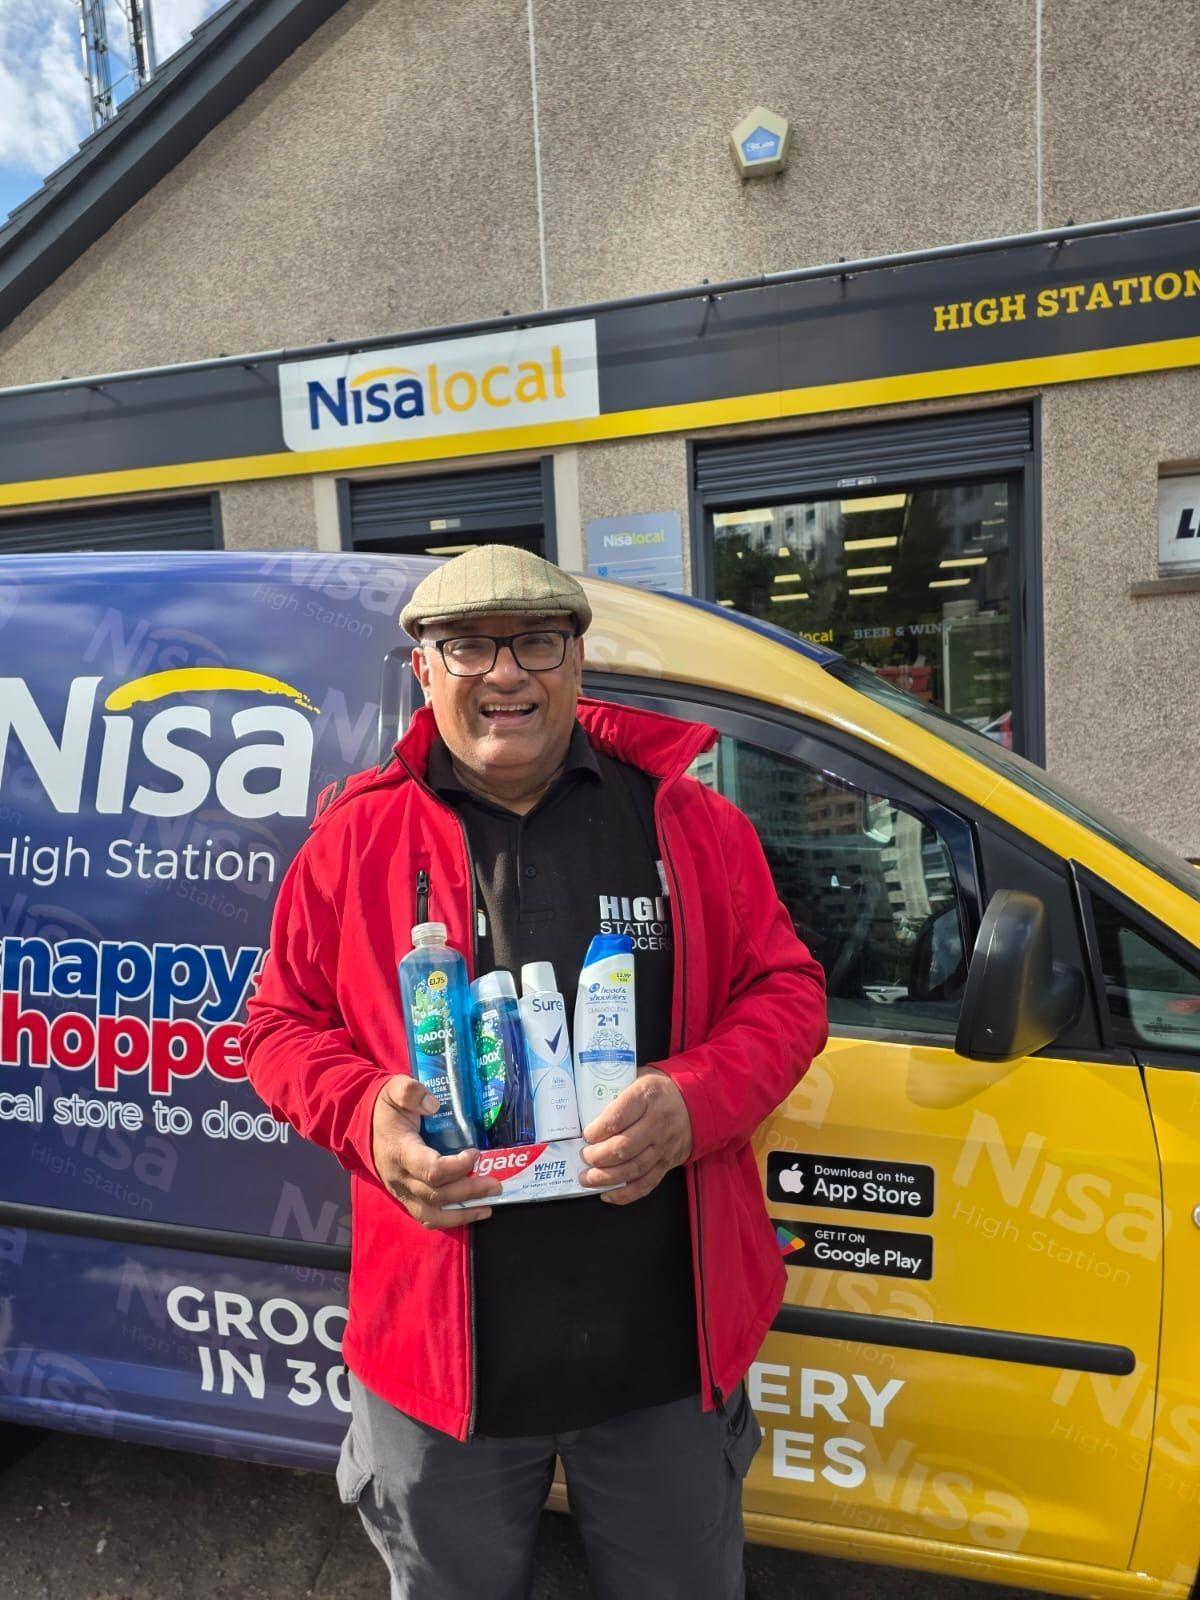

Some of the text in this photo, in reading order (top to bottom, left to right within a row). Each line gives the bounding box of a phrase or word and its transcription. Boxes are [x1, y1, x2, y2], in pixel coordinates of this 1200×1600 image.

[933, 293, 1026, 332] HIGH
[306, 345, 567, 431] Nisalocal
[1176, 507, 1200, 539] L
[799, 629, 834, 643] ocal
[853, 626, 891, 639] BEER
[895, 626, 905, 636] &
[0, 676, 314, 818] Nisa
[105, 838, 276, 883] Station
[600, 921, 668, 936] STATIO
[0, 935, 263, 1024] nappy
[532, 998, 563, 1013] Sure
[416, 1028, 453, 1045] RADOX
[53, 1094, 144, 1131] store
[152, 1100, 193, 1135] to
[202, 1101, 290, 1144] door
[533, 1170, 566, 1181] TEETH
[534, 1160, 567, 1173] WHITE
[814, 1165, 915, 1184] Download on the
[812, 1178, 921, 1206] App Store
[952, 1109, 1172, 1263] Nisa
[814, 1229, 866, 1244] GET IT ON
[951, 1199, 1132, 1289] High Station
[814, 1242, 922, 1274] Google Play
[198, 1345, 868, 1489] IN 30 ES
